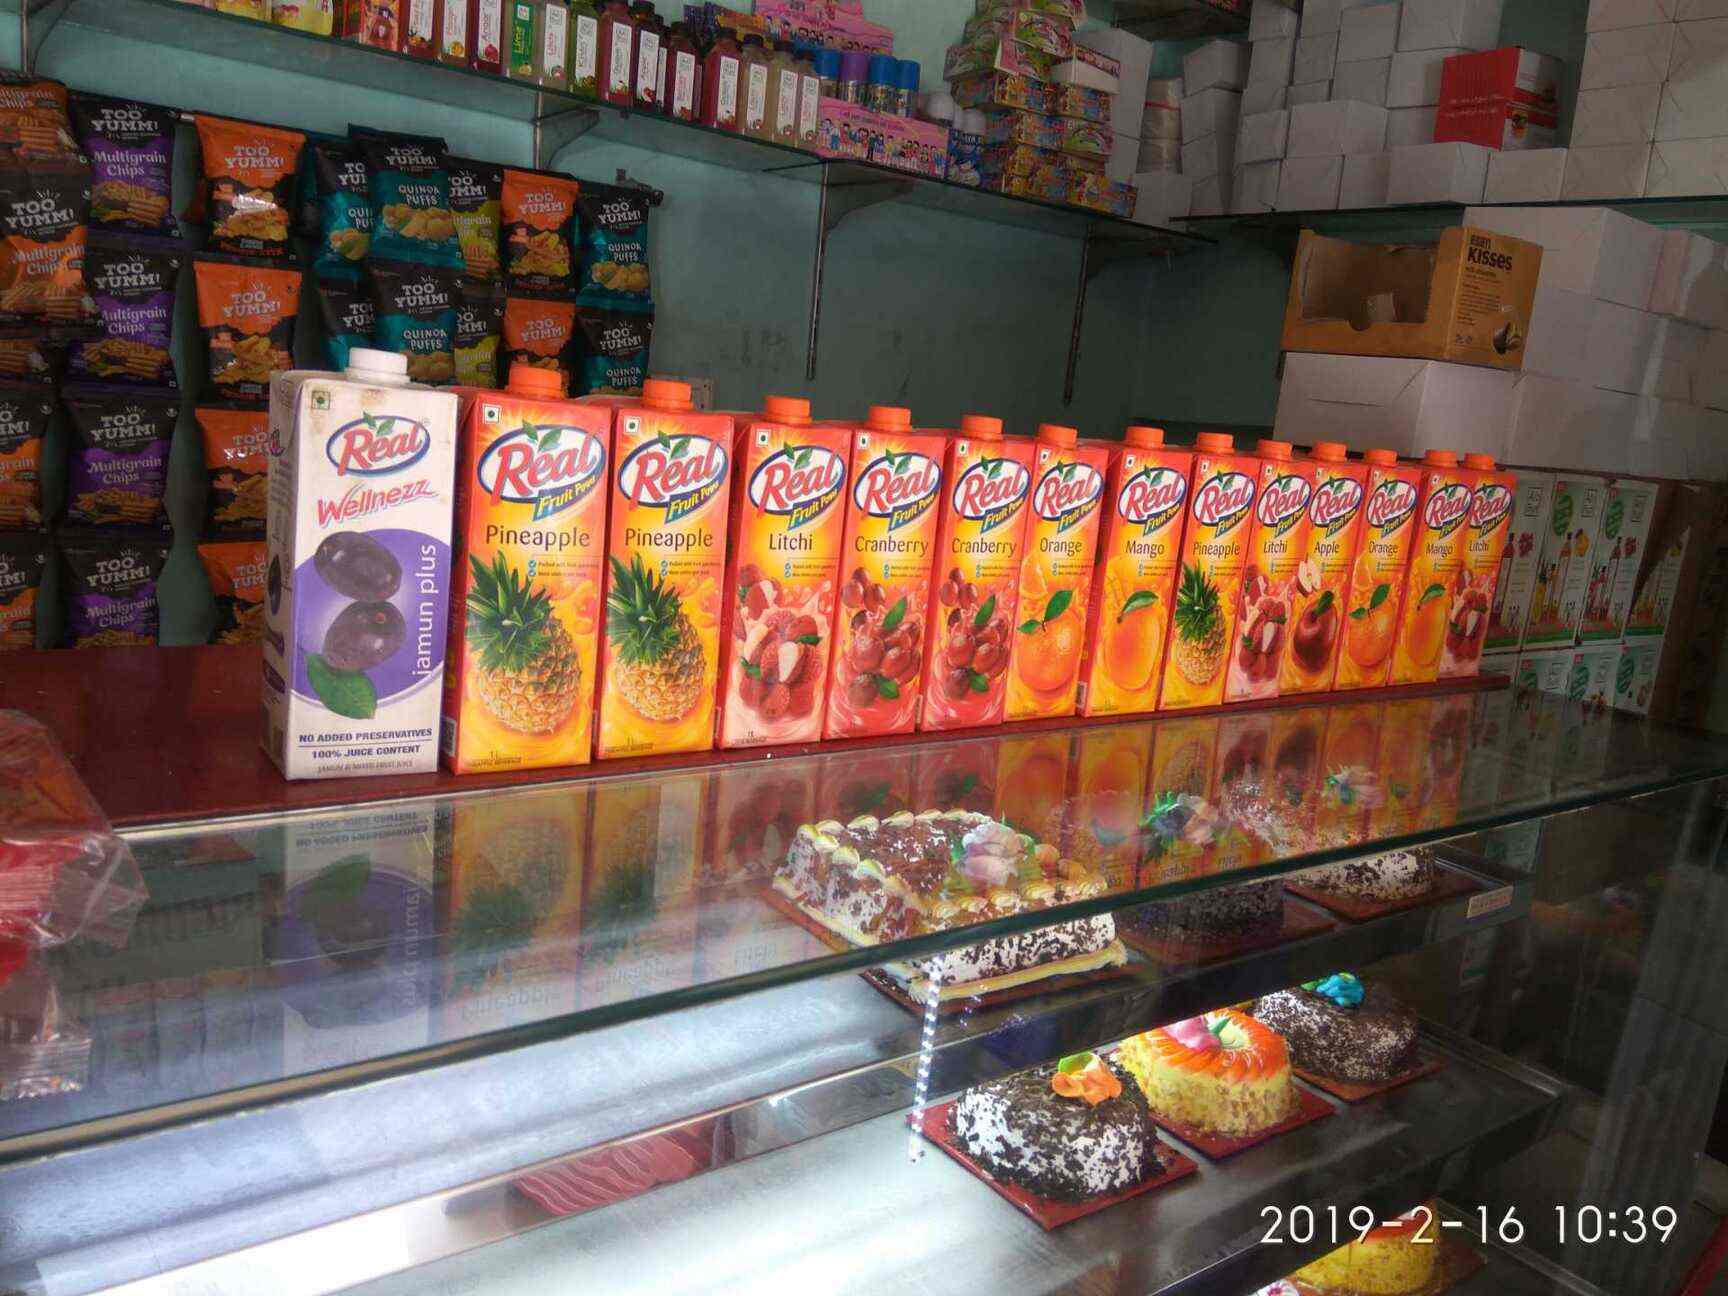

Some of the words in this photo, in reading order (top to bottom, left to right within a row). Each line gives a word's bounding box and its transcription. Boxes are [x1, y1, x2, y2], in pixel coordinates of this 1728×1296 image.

[100, 108, 144, 120] TOO
[90, 119, 160, 133] YUMM!
[92, 150, 167, 167] Multigrain
[233, 145, 270, 157] TOO
[390, 147, 423, 157] TOO
[224, 155, 285, 169] YUMM!
[385, 154, 437, 167] YUMM!
[106, 164, 145, 178] Chips
[450, 175, 473, 187] OO
[398, 184, 440, 196] QUINOA
[524, 192, 554, 203] TOO
[11, 198, 57, 214] TOO
[406, 194, 438, 206] PUFFS
[518, 201, 565, 214] YUMM!
[603, 202, 631, 214] TOO
[5, 208, 75, 229] YUMM!
[598, 210, 642, 225] YUMM!
[14, 244, 87, 265] Multigrain
[608, 242, 642, 253] QUINOA
[613, 251, 639, 262] PUFFS
[103, 262, 145, 276] TOO
[93, 273, 161, 289] YUMM!
[402, 282, 436, 295] TOO
[231, 290, 267, 304] TOO
[395, 292, 449, 309] YUMM!
[221, 301, 281, 317] YUMM!
[107, 321, 145, 336] Chips
[403, 328, 448, 341] QUINOA
[520, 325, 566, 342] YUMM!
[603, 328, 631, 341] TOO
[410, 339, 444, 351] PUFFS
[600, 336, 642, 351] YUMM!
[100, 412, 142, 427] TOO
[90, 424, 157, 441] YUMM!
[337, 422, 424, 477] Real
[87, 456, 163, 474] Multigrain
[490, 432, 599, 505] Real
[102, 470, 140, 485] Chips
[630, 439, 720, 511] Real
[758, 452, 840, 518] Real
[862, 456, 937, 521] Real
[959, 463, 1025, 518] Real
[1037, 470, 1100, 518] Real
[1122, 473, 1186, 522] Real
[1199, 478, 1253, 525] Real
[317, 479, 439, 528] Wellnezz
[537, 489, 573, 517] Fruit
[667, 493, 699, 520] Fruit
[1261, 480, 1309, 526] Real
[1312, 482, 1360, 525] Real
[1369, 485, 1414, 526] Real
[1429, 490, 1470, 528] Real
[1470, 490, 1509, 526] Real
[485, 525, 592, 552] Pineapple
[624, 528, 714, 552] Pineapple
[768, 532, 814, 552] Litchi
[854, 535, 930, 558] Cranberry
[1263, 539, 1288, 554] Litchi
[951, 537, 1017, 559] Cranberry
[1039, 536, 1082, 559] Orange
[1125, 539, 1166, 559] Mango
[1192, 541, 1241, 560] Pineapple
[1313, 541, 1340, 556] Apple
[95, 556, 136, 571] TOO
[415, 544, 440, 594] plus
[86, 565, 150, 587] YUMM!
[85, 597, 157, 619] Multigrain
[99, 613, 137, 628] Chips
[412, 601, 435, 677] jamun
[299, 734, 315, 744] NO
[317, 731, 353, 743] ADDED
[355, 727, 433, 741] PRESERVATIVES
[311, 749, 341, 760] 100%
[343, 747, 374, 758] JUICE
[376, 744, 421, 756] CONTENT
